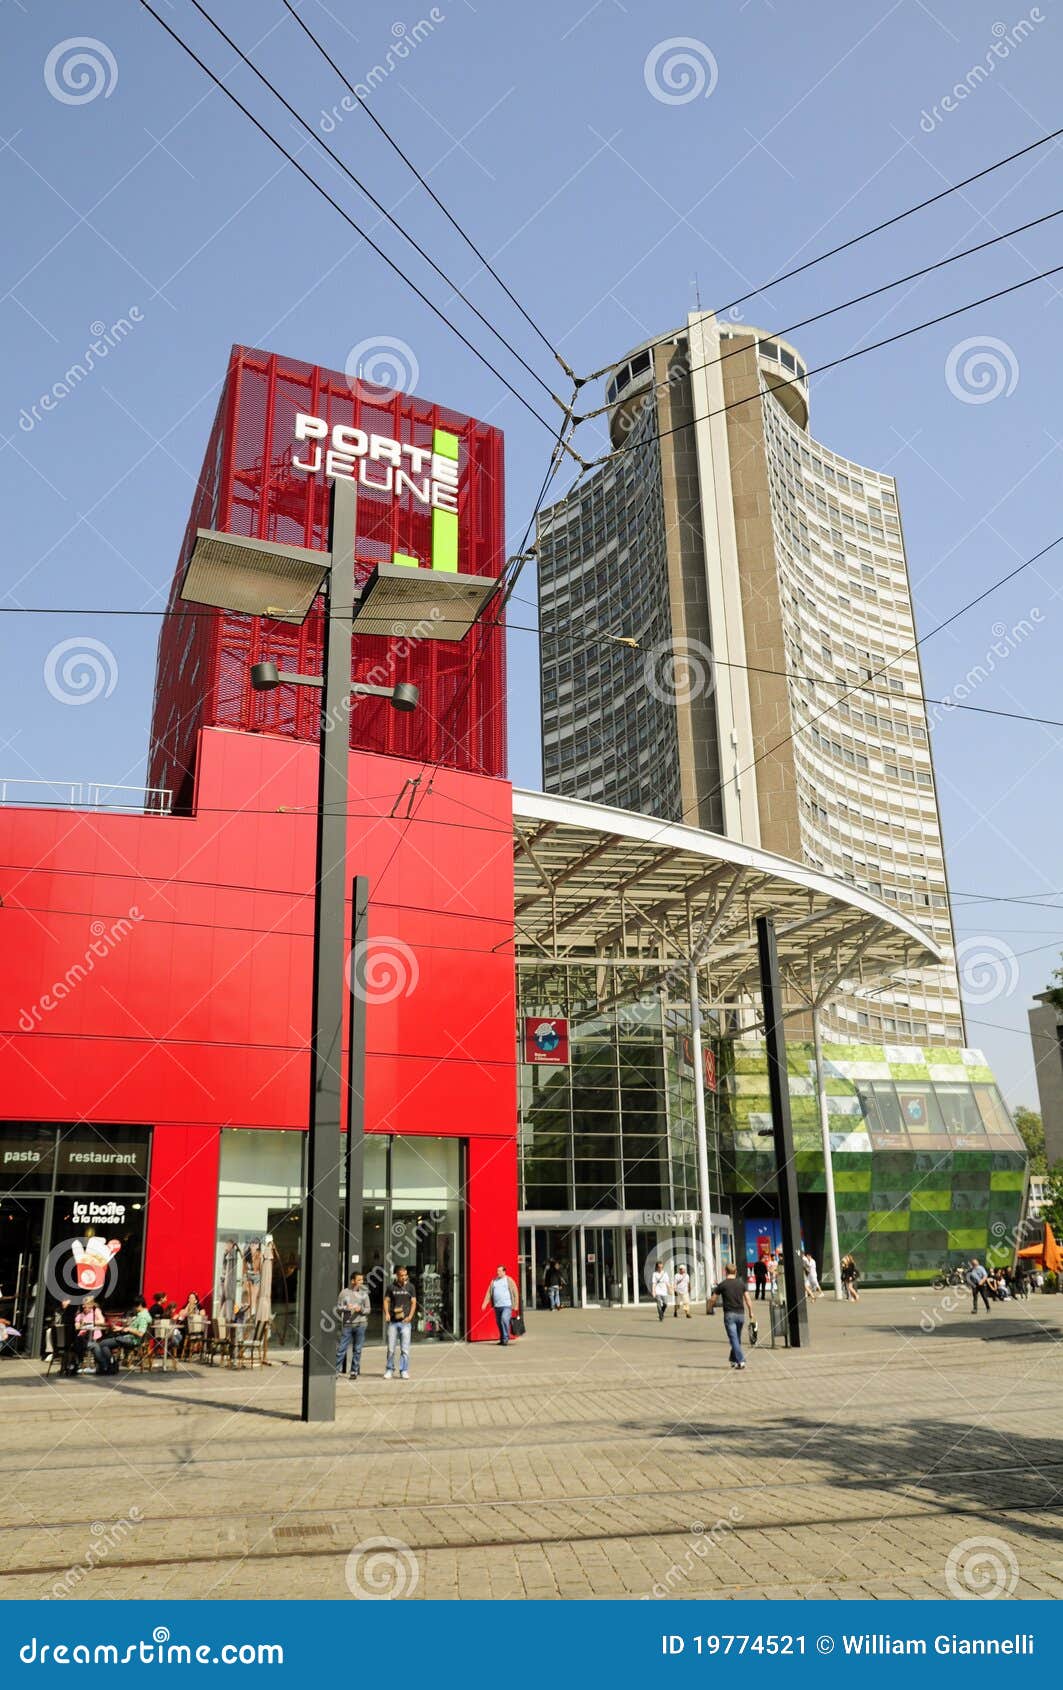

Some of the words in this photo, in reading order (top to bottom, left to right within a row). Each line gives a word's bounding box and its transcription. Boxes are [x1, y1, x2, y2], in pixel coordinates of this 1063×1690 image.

[295, 412, 459, 487] PORTE
[292, 446, 459, 514] JEUNE
[4, 1150, 41, 1164] pasta
[69, 1151, 137, 1164] restaurant
[73, 1200, 88, 1215] la
